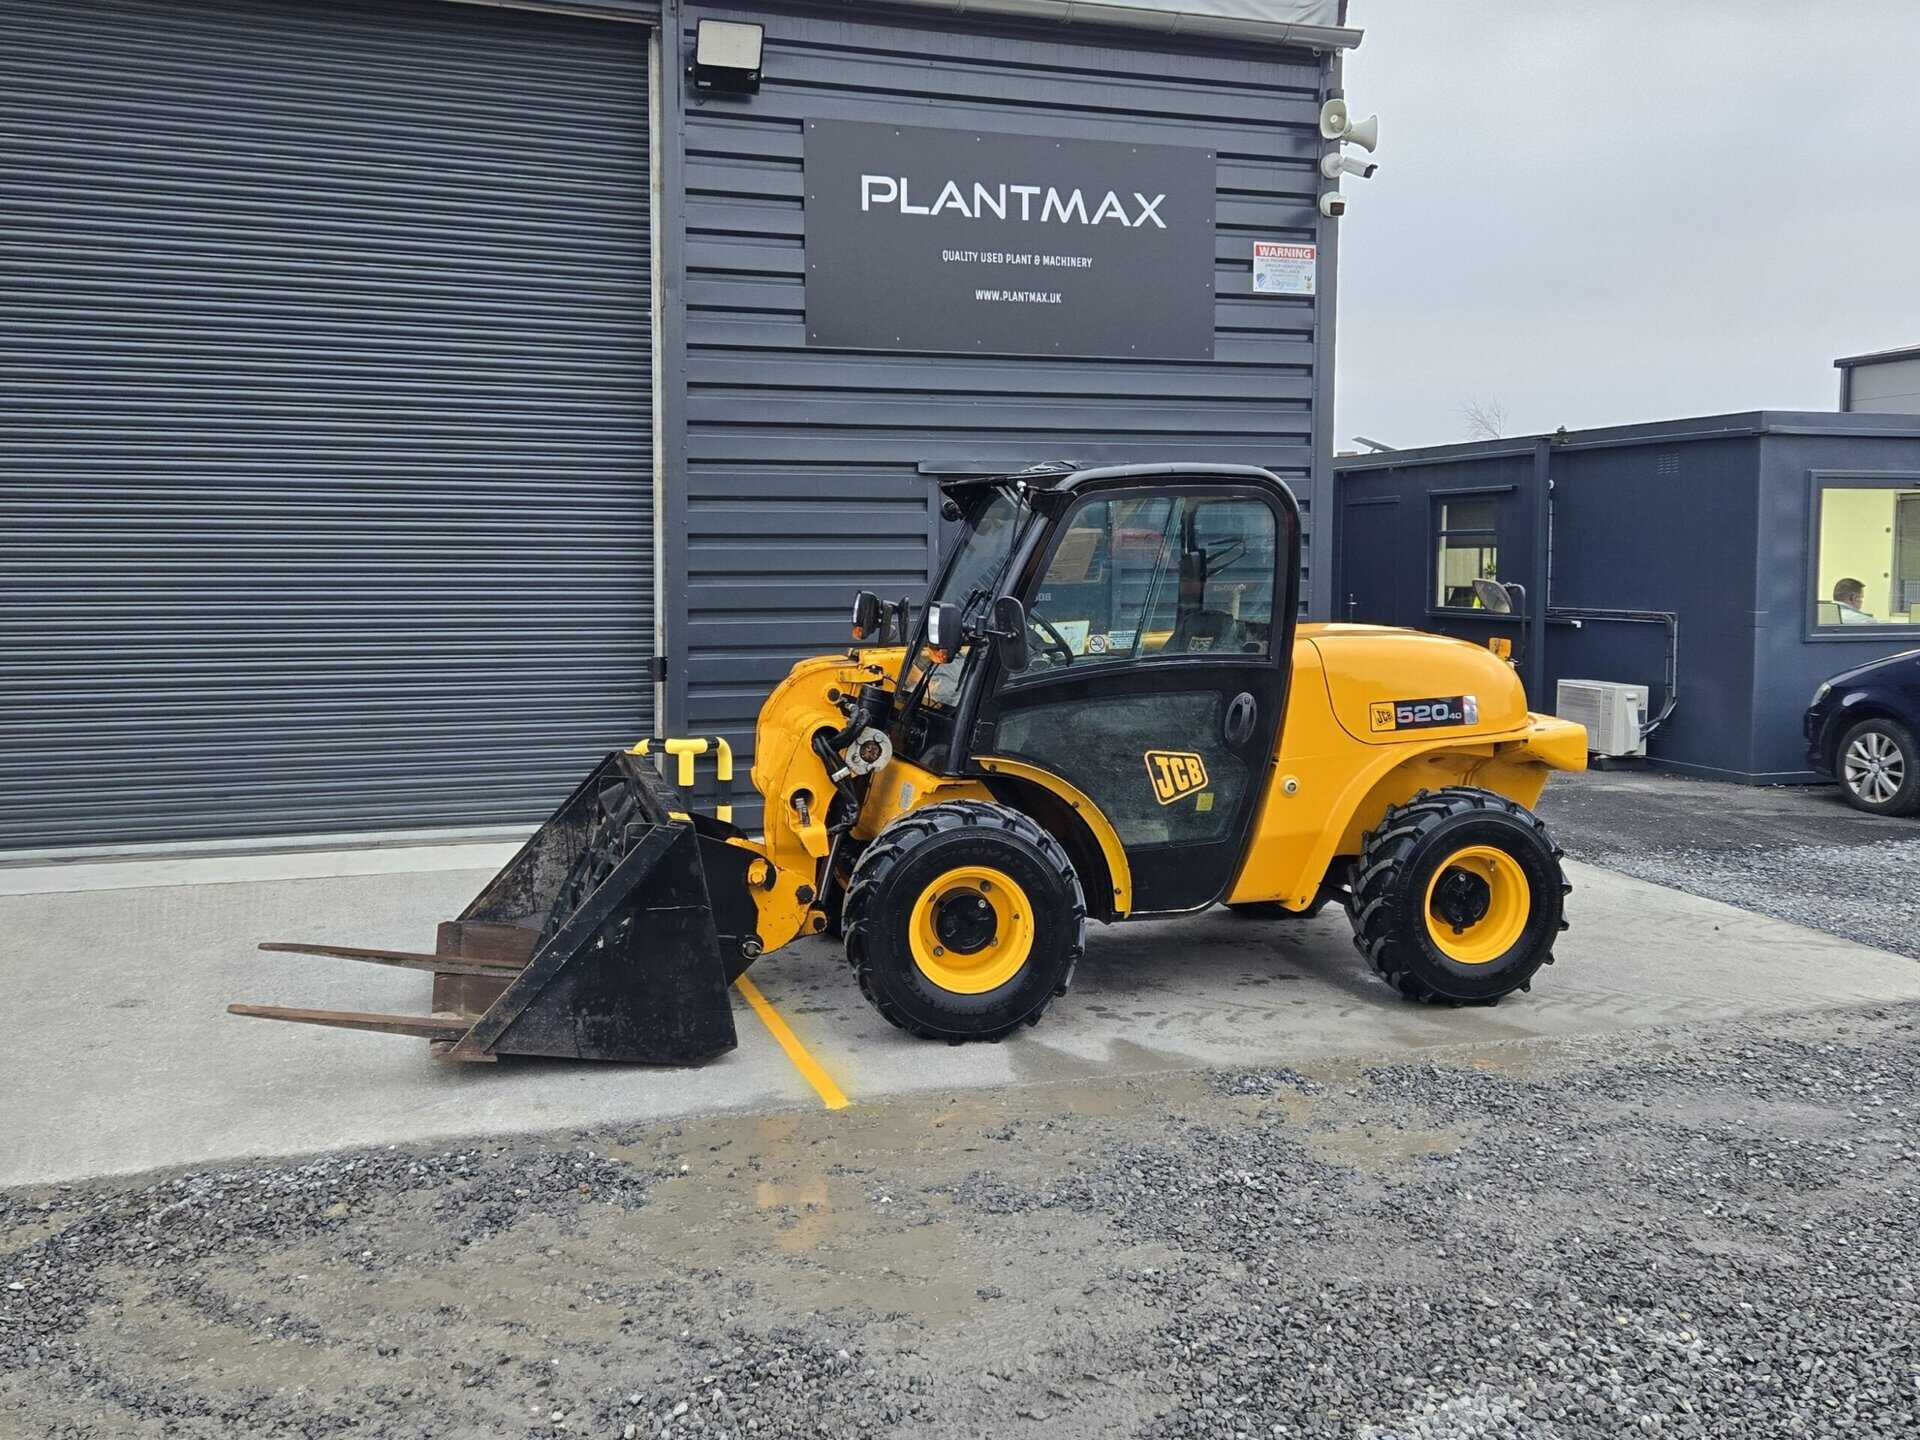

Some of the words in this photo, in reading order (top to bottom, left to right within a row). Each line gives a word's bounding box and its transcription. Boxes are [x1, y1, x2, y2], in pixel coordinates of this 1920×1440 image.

[861, 174, 1167, 229] PLANTMAX
[942, 250, 978, 263] QUALITY
[981, 252, 1003, 264] USED
[1006, 254, 1032, 265] PLANT
[1034, 255, 1041, 265] &
[1043, 256, 1093, 268] MACHINERY
[1259, 246, 1312, 258] WARNING
[975, 289, 1062, 303] WWW.PLANTMAX.UK
[1375, 710, 1393, 723] JCB
[1396, 704, 1448, 723] 520
[1154, 756, 1203, 798] JCB
